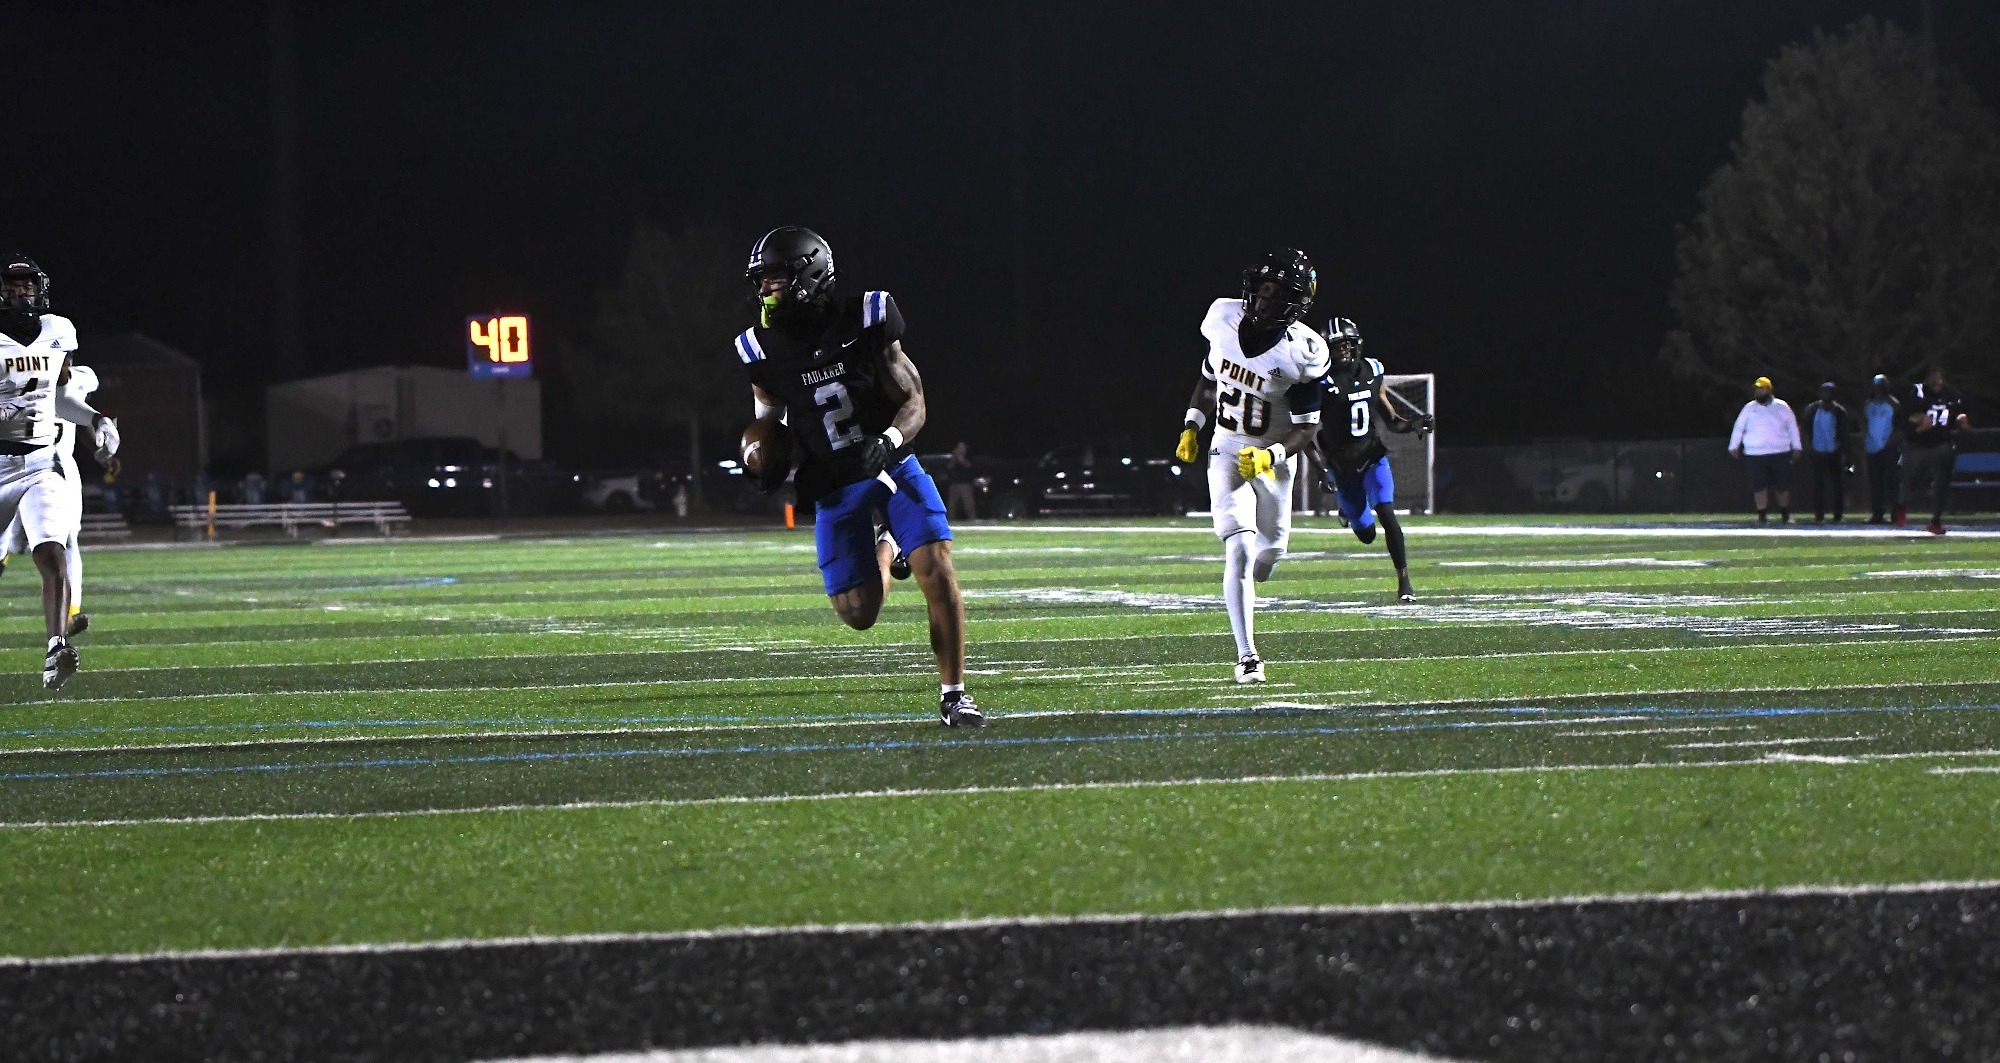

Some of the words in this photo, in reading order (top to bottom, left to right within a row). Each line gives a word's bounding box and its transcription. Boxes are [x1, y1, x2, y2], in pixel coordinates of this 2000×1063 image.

[470, 317, 528, 362] 40
[5, 356, 50, 373] POINT
[801, 362, 846, 386] FAULKNER
[1220, 358, 1266, 391] POINT
[814, 382, 863, 451] 2
[1218, 387, 1272, 437] 20
[1351, 400, 1369, 437] 0
